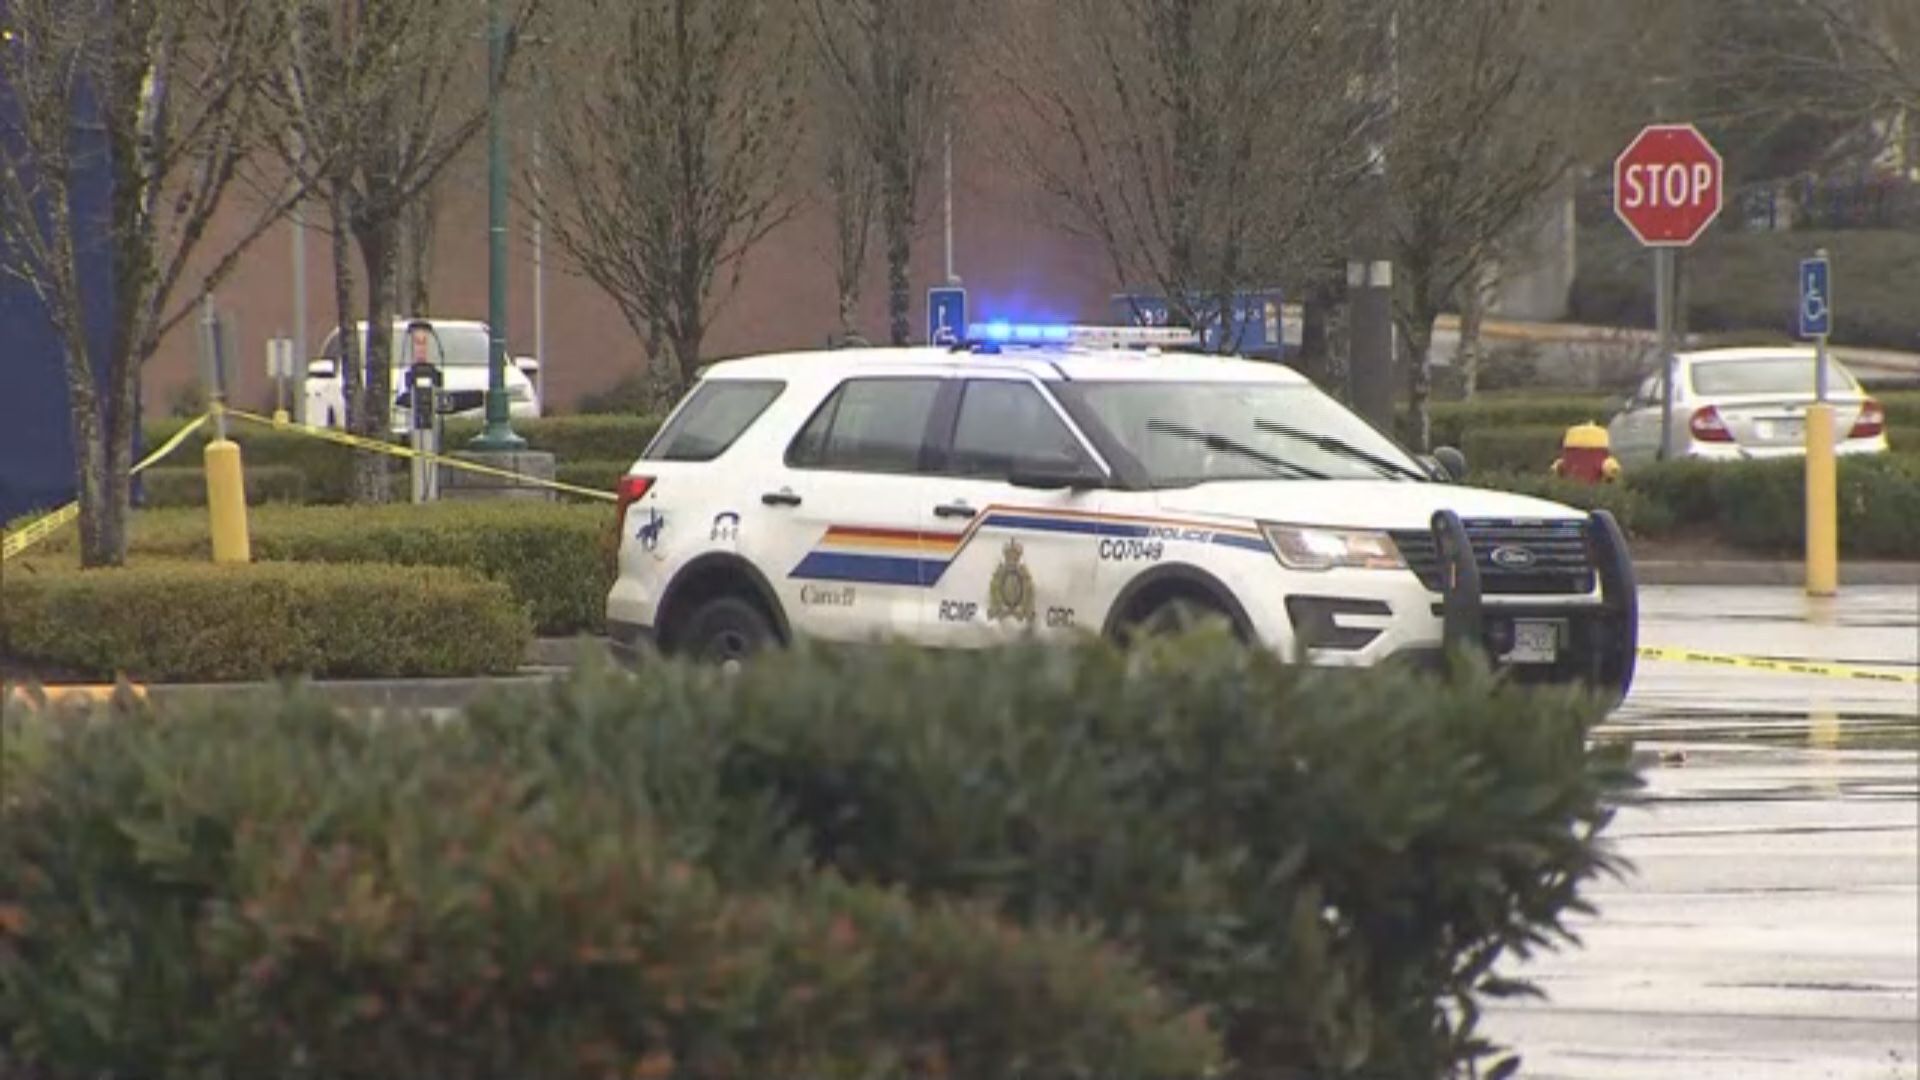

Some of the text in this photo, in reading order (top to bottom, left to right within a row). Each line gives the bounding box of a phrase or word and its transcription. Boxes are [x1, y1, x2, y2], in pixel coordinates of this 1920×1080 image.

[1625, 163, 1712, 208] STOP
[1148, 526, 1213, 544] POLICE
[1100, 538, 1164, 561] CQ7049
[939, 599, 978, 621] RCMP
[1046, 605, 1075, 628] GRC
